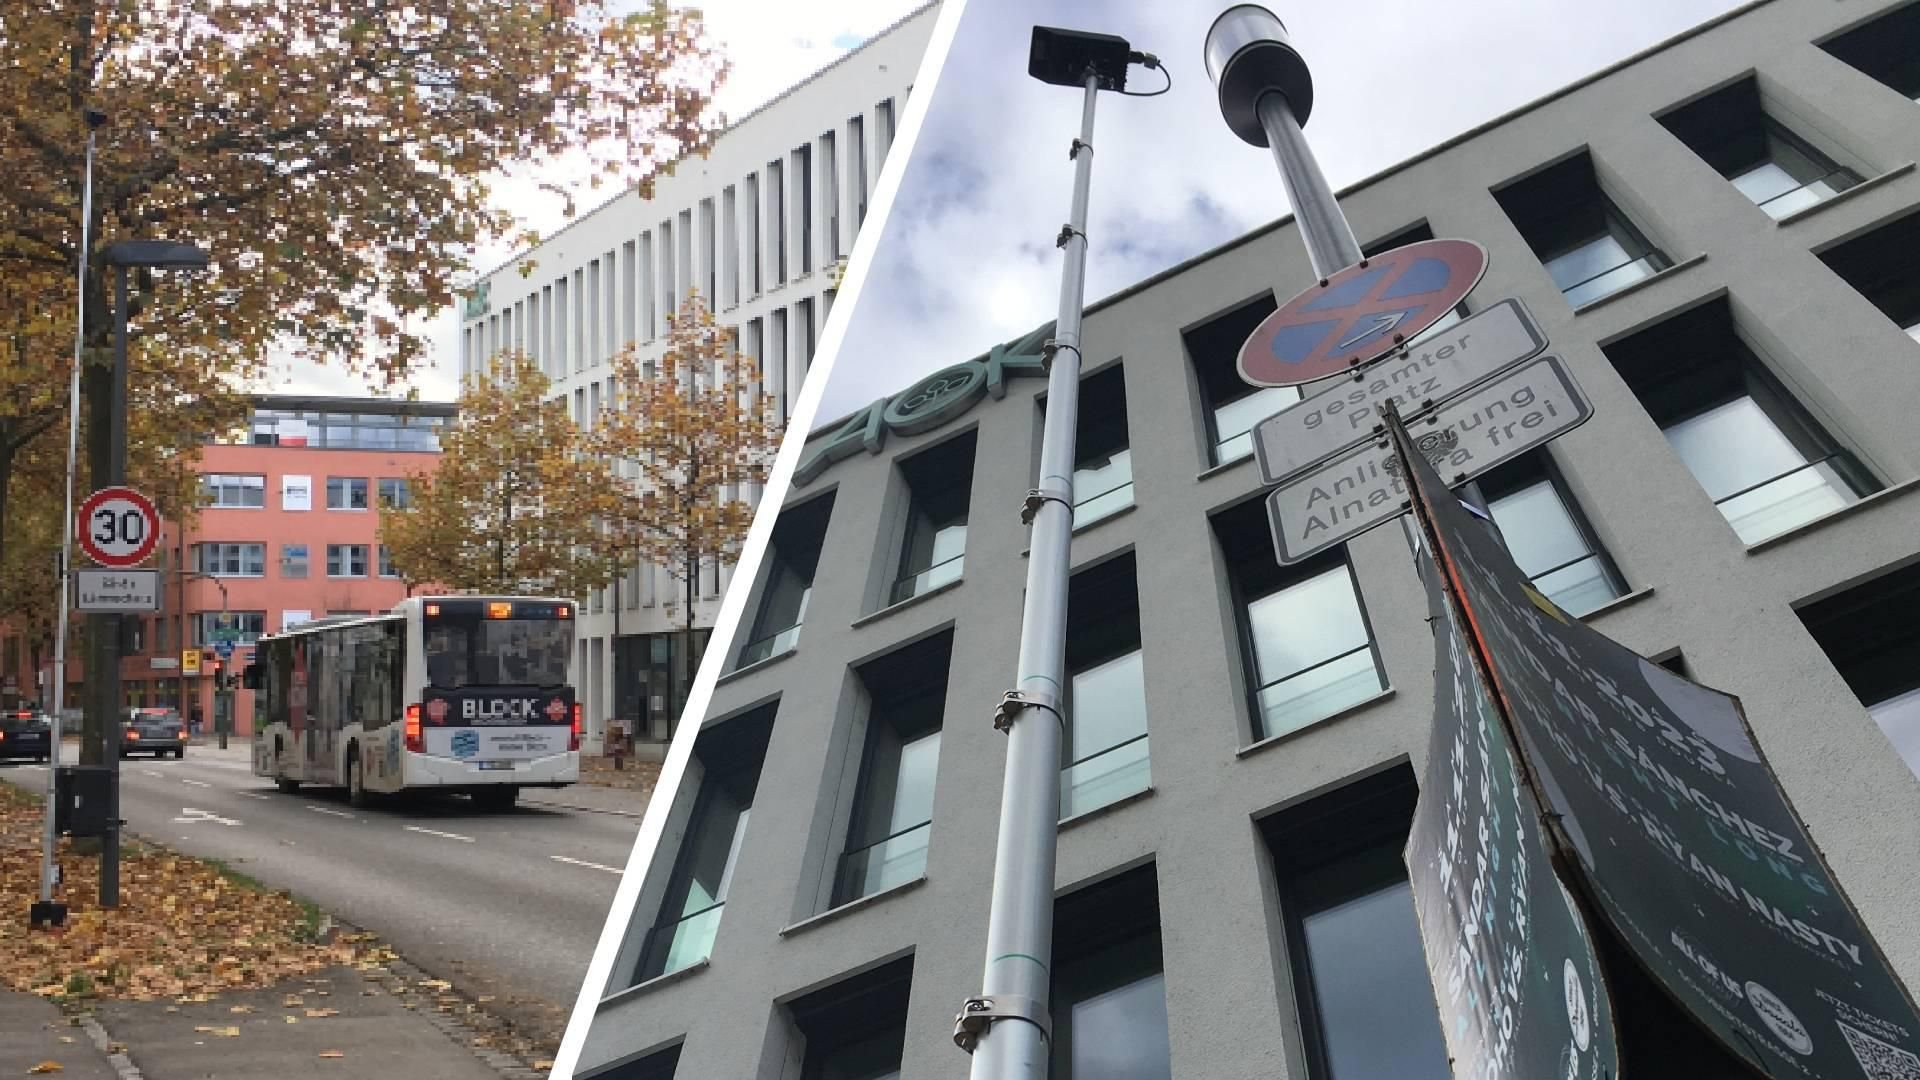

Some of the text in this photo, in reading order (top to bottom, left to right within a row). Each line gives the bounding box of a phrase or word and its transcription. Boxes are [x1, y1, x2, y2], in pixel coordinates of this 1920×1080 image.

[1303, 333, 1473, 430] gesamter
[1349, 376, 1442, 429] Platz
[94, 509, 143, 545] 30
[1302, 400, 1559, 540] Alnatra frei
[1449, 814, 1490, 1007] SANDAR
[1639, 812, 1740, 901] RYAN
[1740, 886, 1863, 967] NASTY
